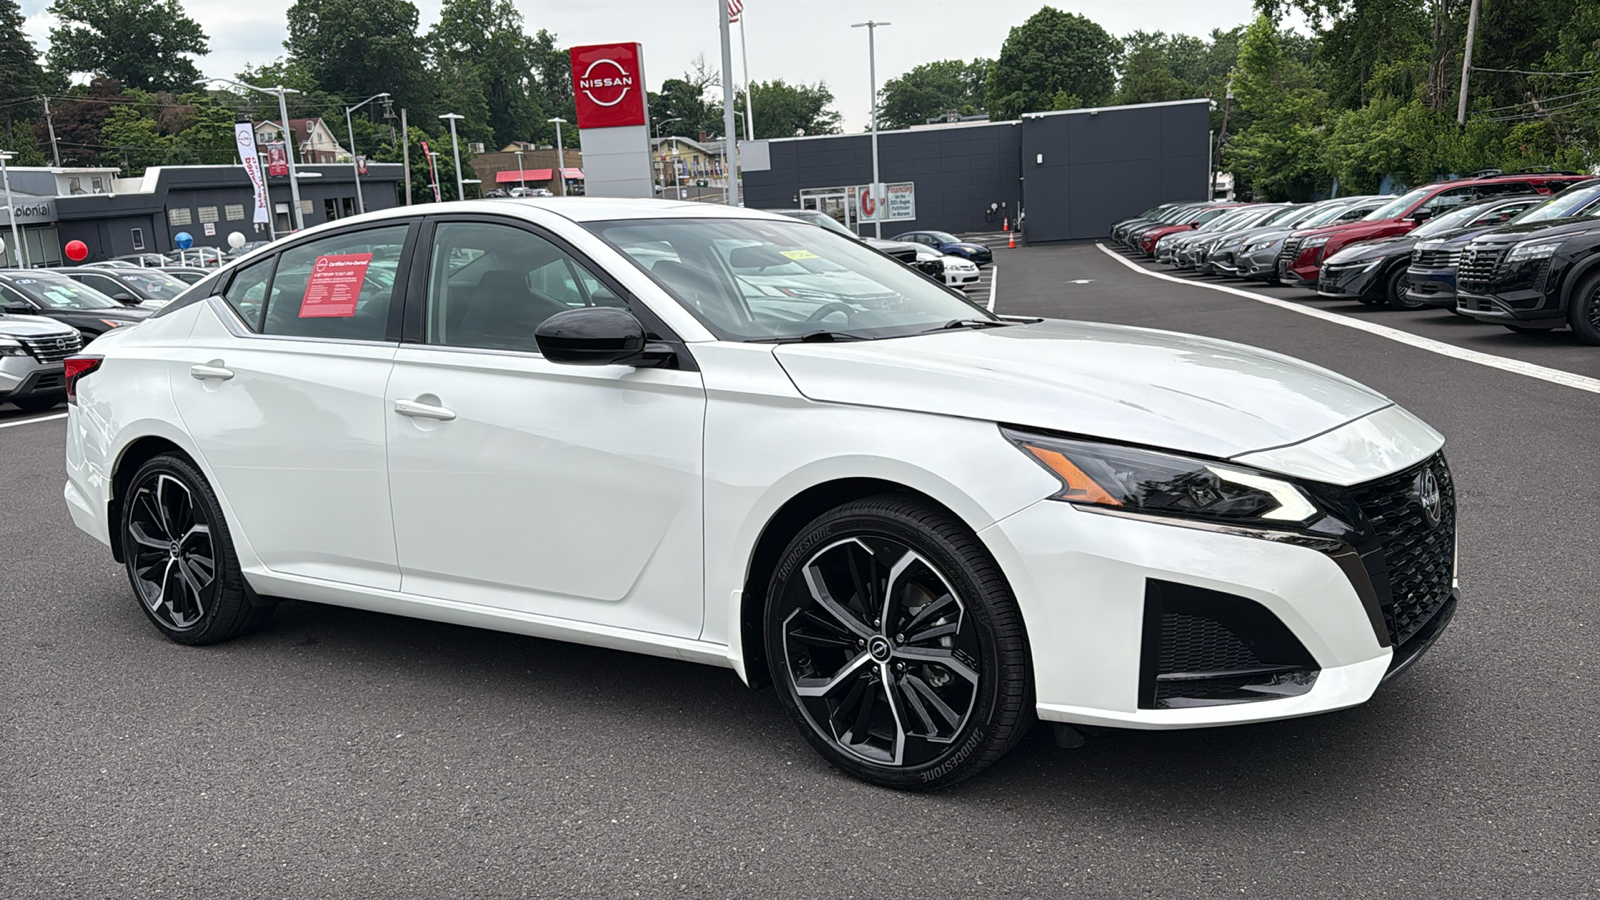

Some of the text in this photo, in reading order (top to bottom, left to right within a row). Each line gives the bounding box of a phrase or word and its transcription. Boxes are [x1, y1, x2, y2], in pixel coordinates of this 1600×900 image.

[579, 76, 632, 89] NISSAN
[778, 525, 832, 581] BRIDGESTONE
[920, 727, 984, 783] BRIDGESTONE
